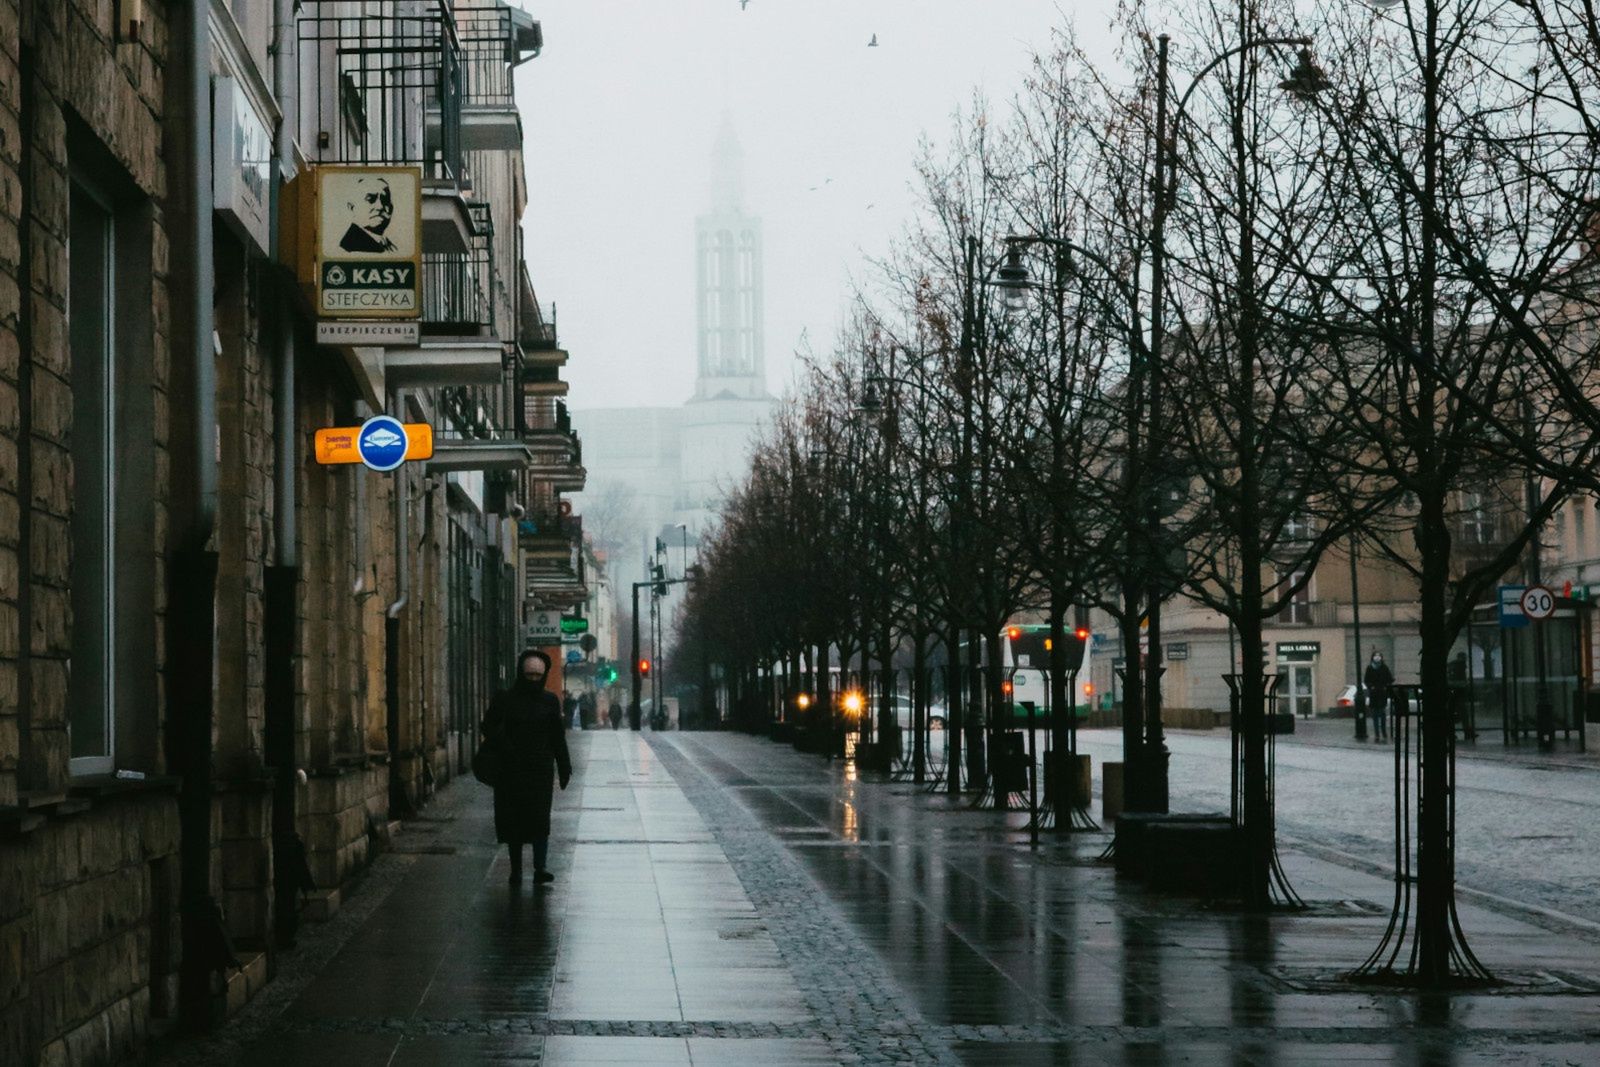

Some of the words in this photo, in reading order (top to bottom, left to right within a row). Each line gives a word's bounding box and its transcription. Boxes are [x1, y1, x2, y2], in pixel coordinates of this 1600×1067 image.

[352, 268, 410, 284] KASY
[327, 292, 411, 306] STEFCZYKA
[320, 327, 416, 335] UBEZPIECZENIA
[1527, 594, 1552, 612] 30
[529, 626, 557, 634] SKOK
